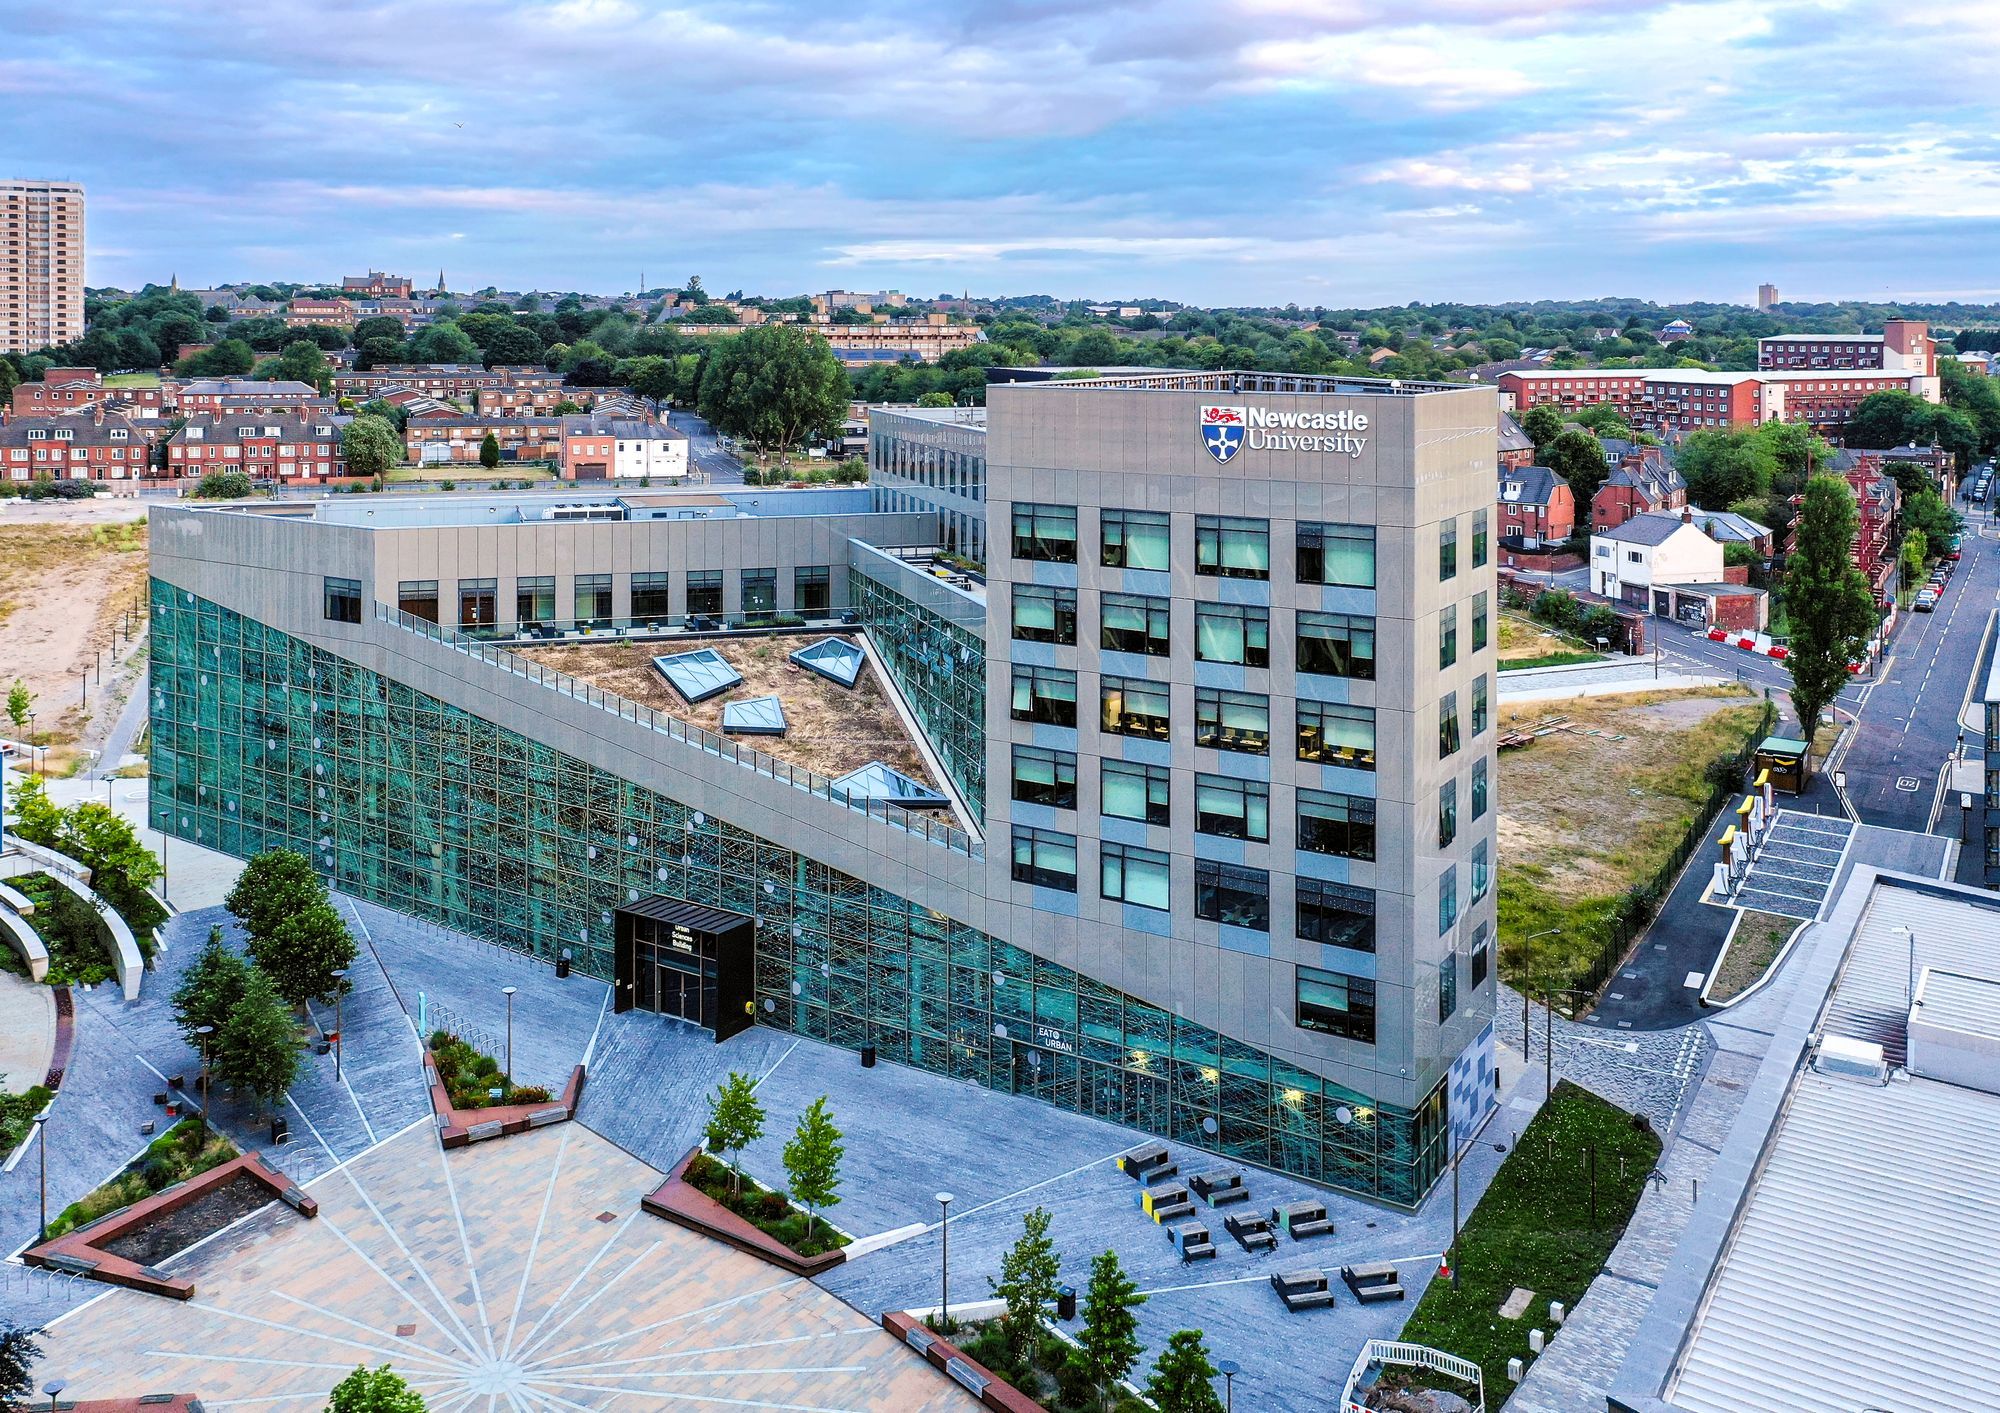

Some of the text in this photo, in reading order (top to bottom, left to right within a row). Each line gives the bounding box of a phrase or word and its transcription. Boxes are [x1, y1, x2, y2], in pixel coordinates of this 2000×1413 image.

[1249, 407, 1368, 431] Newcastle
[1247, 428, 1367, 458] University
[672, 931, 693, 942] Sciences
[673, 939, 692, 951] Building
[1045, 1038, 1072, 1052] URBAN
